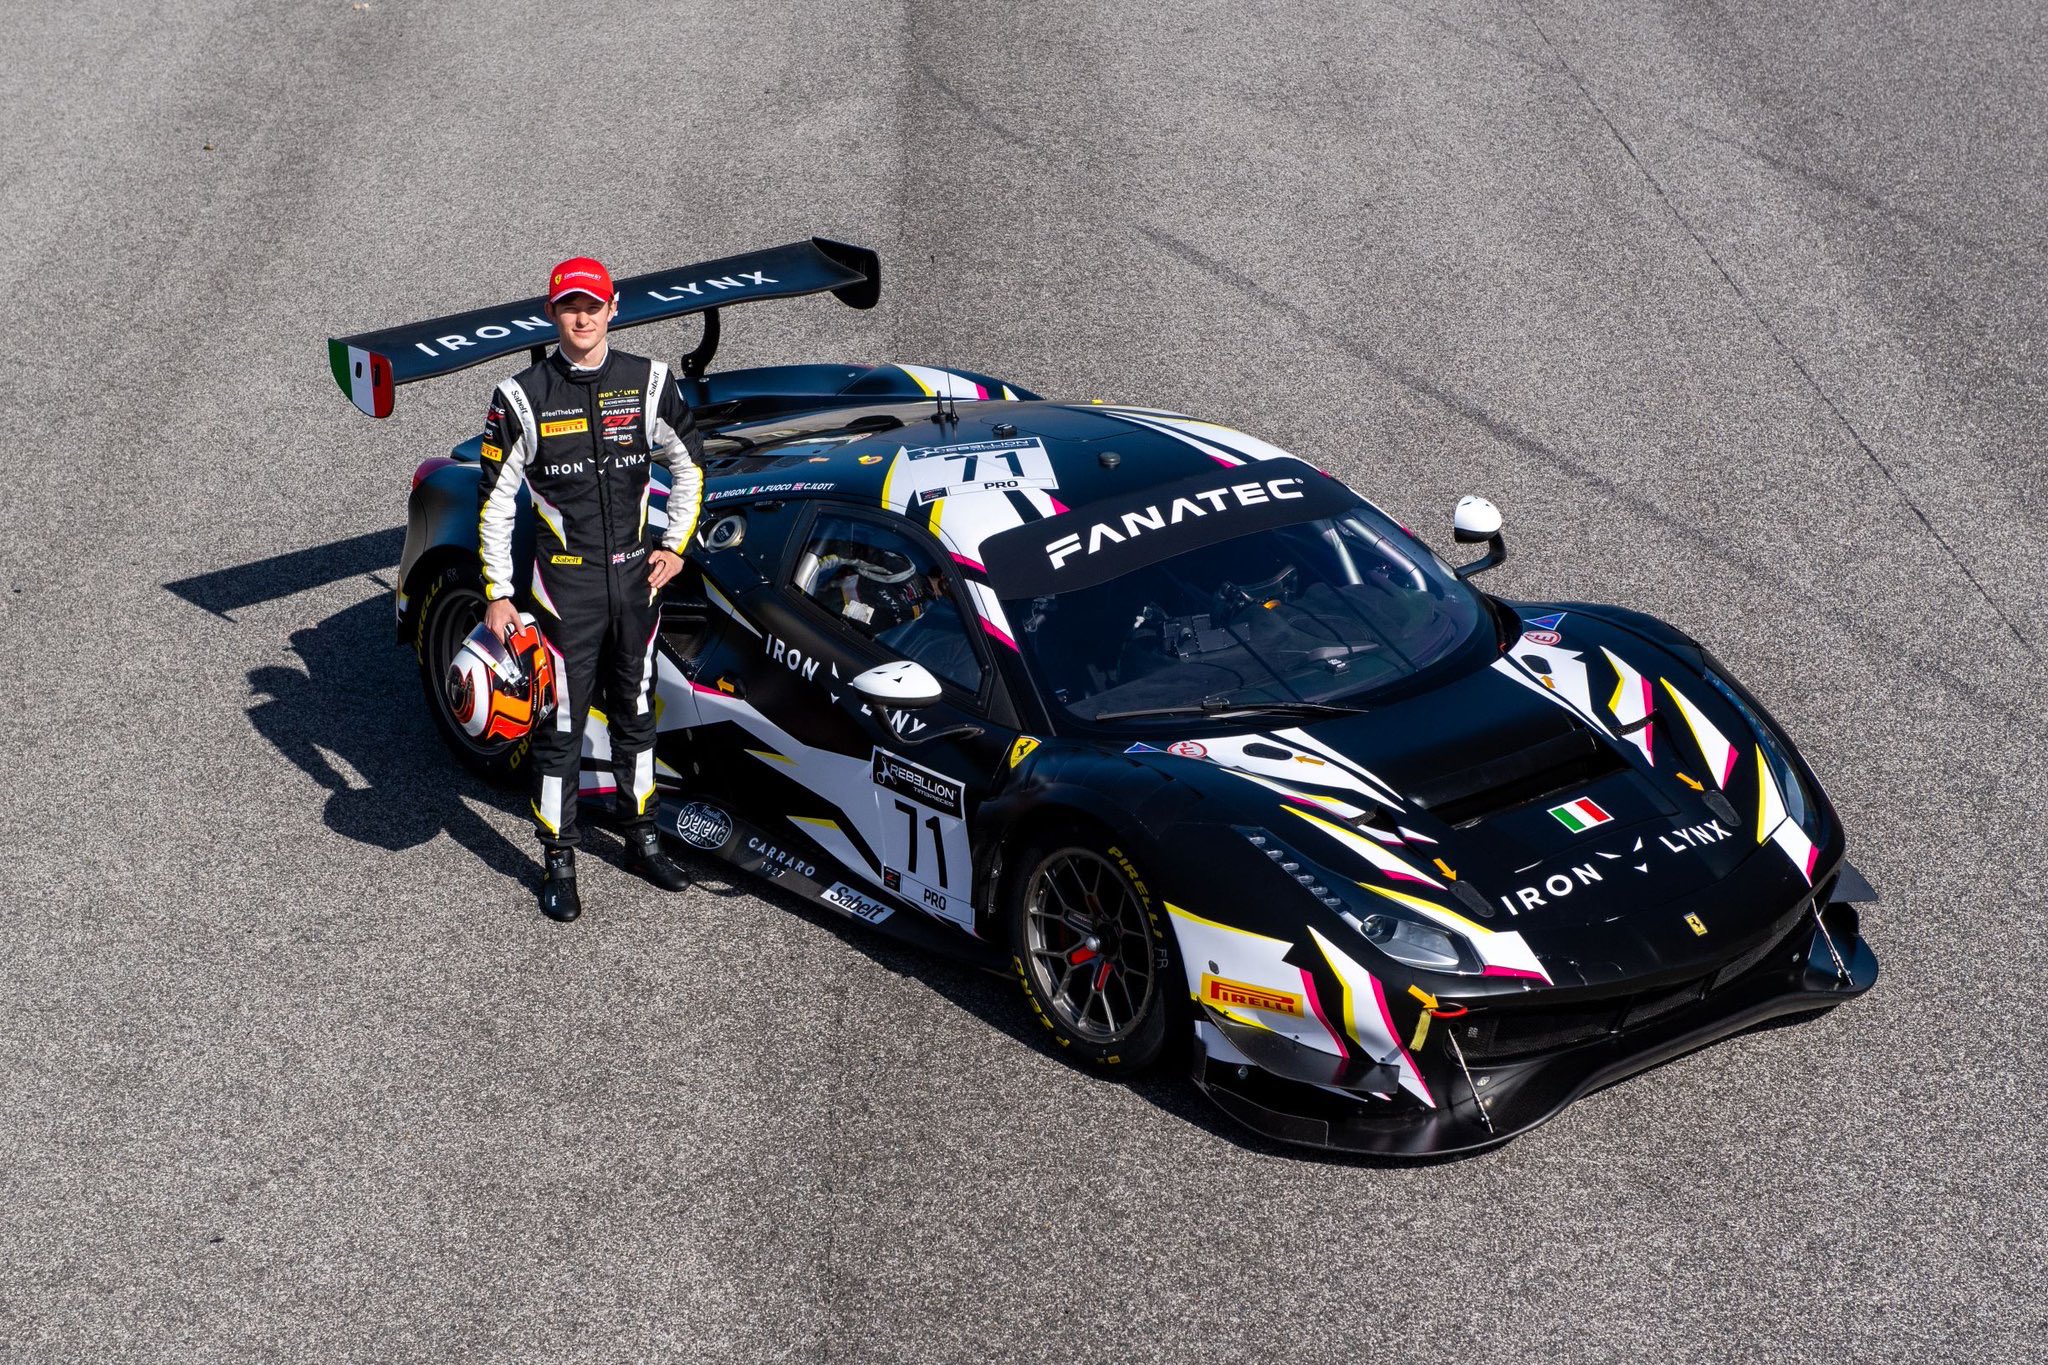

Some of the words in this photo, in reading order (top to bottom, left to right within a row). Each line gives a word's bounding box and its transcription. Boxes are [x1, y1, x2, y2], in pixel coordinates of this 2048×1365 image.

[415, 316, 553, 358] IRON
[648, 270, 779, 302] LYNX
[649, 370, 661, 397] Sabelt
[511, 390, 528, 414] Sabelt
[601, 407, 641, 416] FANATEC
[545, 420, 583, 433] PIRELLI
[544, 462, 583, 475] IRON
[615, 453, 646, 469] LYNX
[944, 451, 1025, 482] 71
[715, 488, 747, 500] D.RIGON
[757, 483, 792, 493] A.FUOCO
[803, 482, 835, 490] C.ILOTT
[983, 480, 1018, 490] PRO
[1045, 478, 1304, 570] FANATEC
[555, 555, 579, 564] Sabelt
[765, 633, 820, 682] IRON
[890, 763, 955, 800] REBELLION
[678, 804, 730, 846] Beretta
[748, 837, 816, 877] CARRARO
[894, 798, 948, 889] 71
[760, 861, 786, 879] 1927
[1500, 863, 1604, 916] IRON
[1658, 819, 1733, 853] LYNX
[829, 886, 885, 921] Sabelt
[923, 888, 946, 911] PRO
[1107, 845, 1164, 939] PIRELLI
[1154, 946, 1169, 969] FR
[1210, 980, 1295, 1013] PIRELLI
